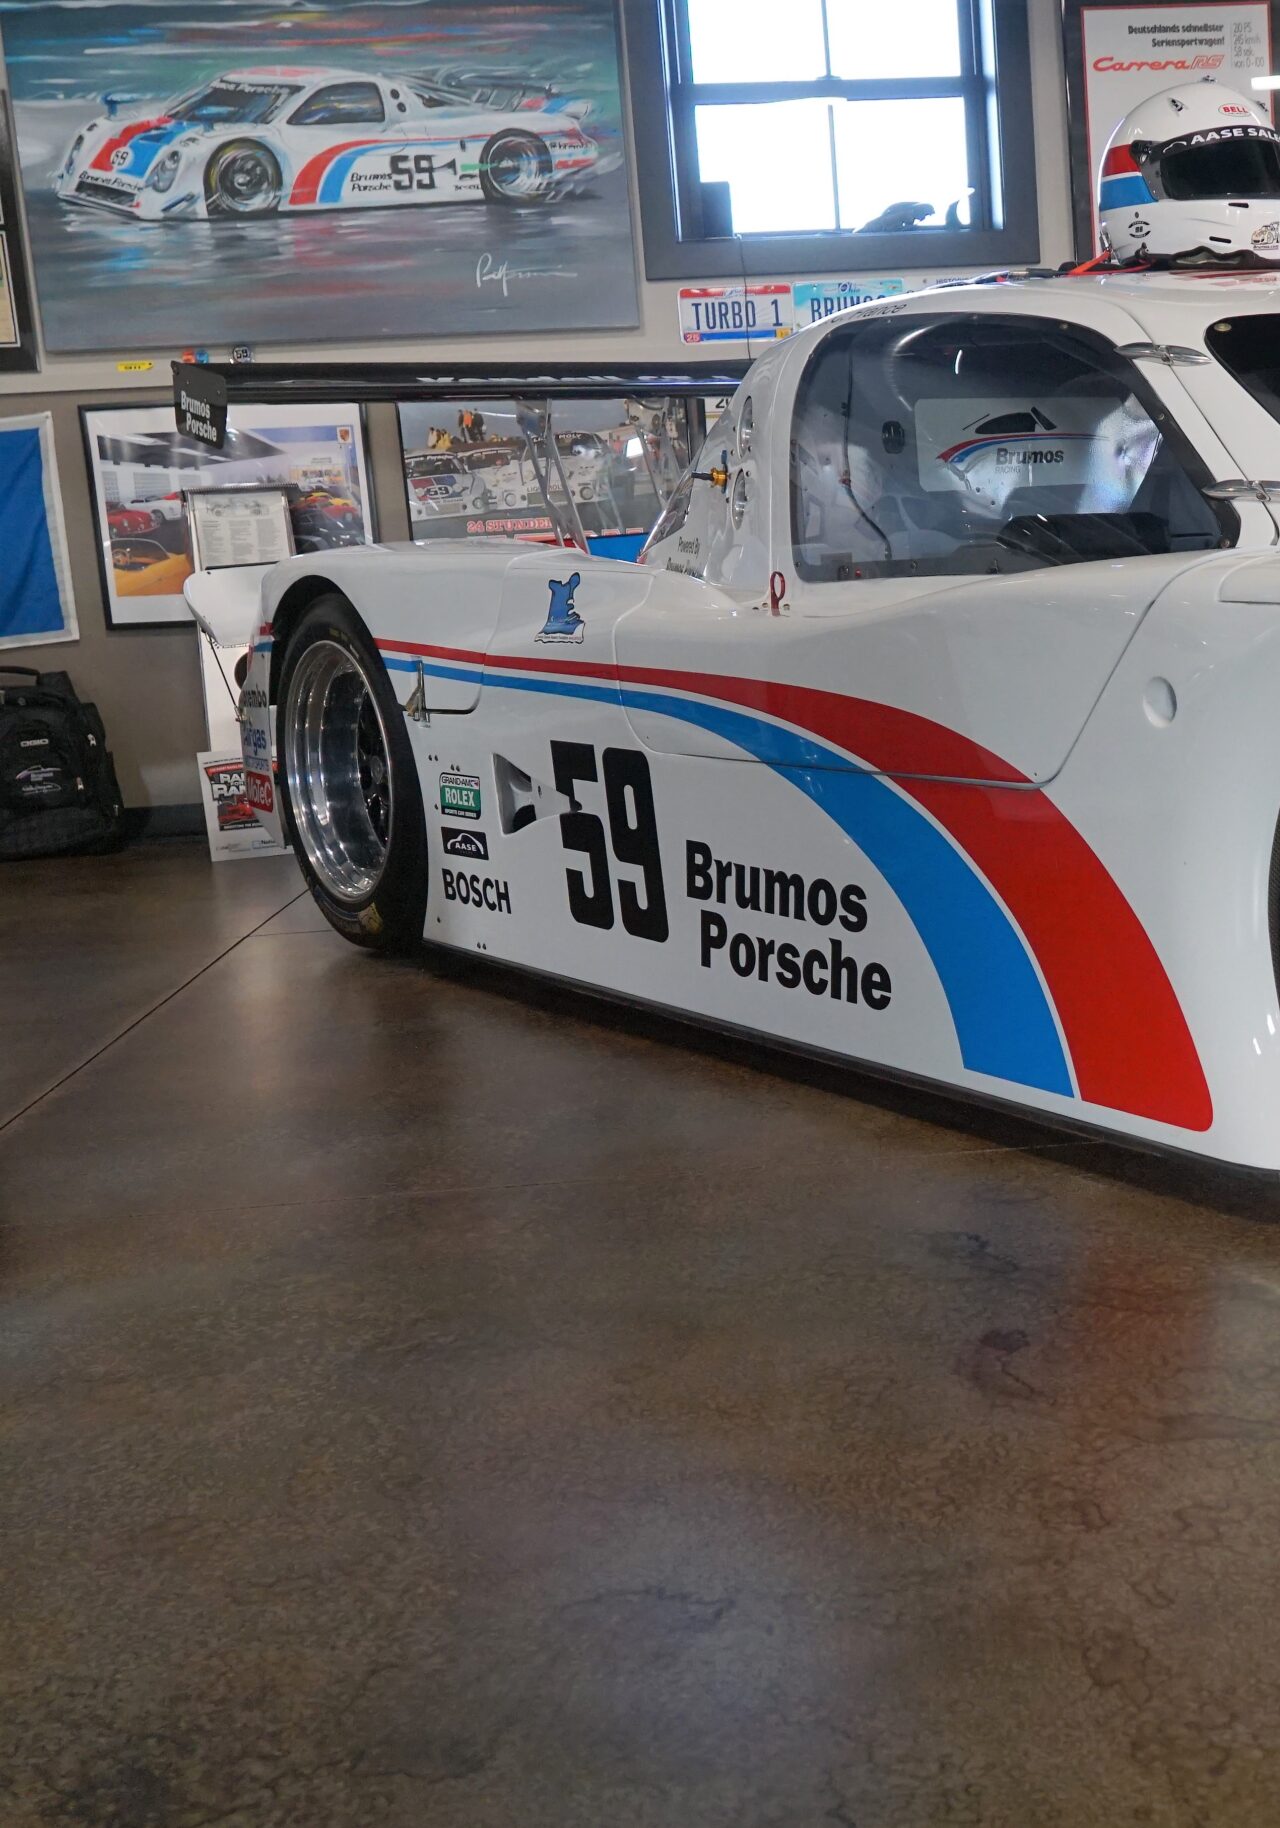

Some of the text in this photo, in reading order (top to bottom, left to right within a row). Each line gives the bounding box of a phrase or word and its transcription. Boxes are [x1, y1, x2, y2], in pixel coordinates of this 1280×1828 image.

[1128, 23, 1224, 34] Deutschlands schnellster
[1092, 54, 1225, 72] Carrera RS
[1222, 106, 1249, 114] BELL
[1190, 127, 1245, 146] AASE
[389, 154, 436, 191] 59
[691, 298, 783, 331] TURBO 1
[180, 390, 211, 419] Brumos
[186, 412, 218, 443] Porsche
[996, 447, 1065, 467] Brumos
[428, 484, 451, 496] 59
[466, 520, 485, 534] 24
[444, 786, 476, 808] ROLEX
[455, 841, 478, 853] AASE
[550, 740, 670, 944] 59
[441, 867, 513, 915] BOSCH
[685, 839, 869, 933] Brumos
[700, 908, 893, 1011] Porsche
